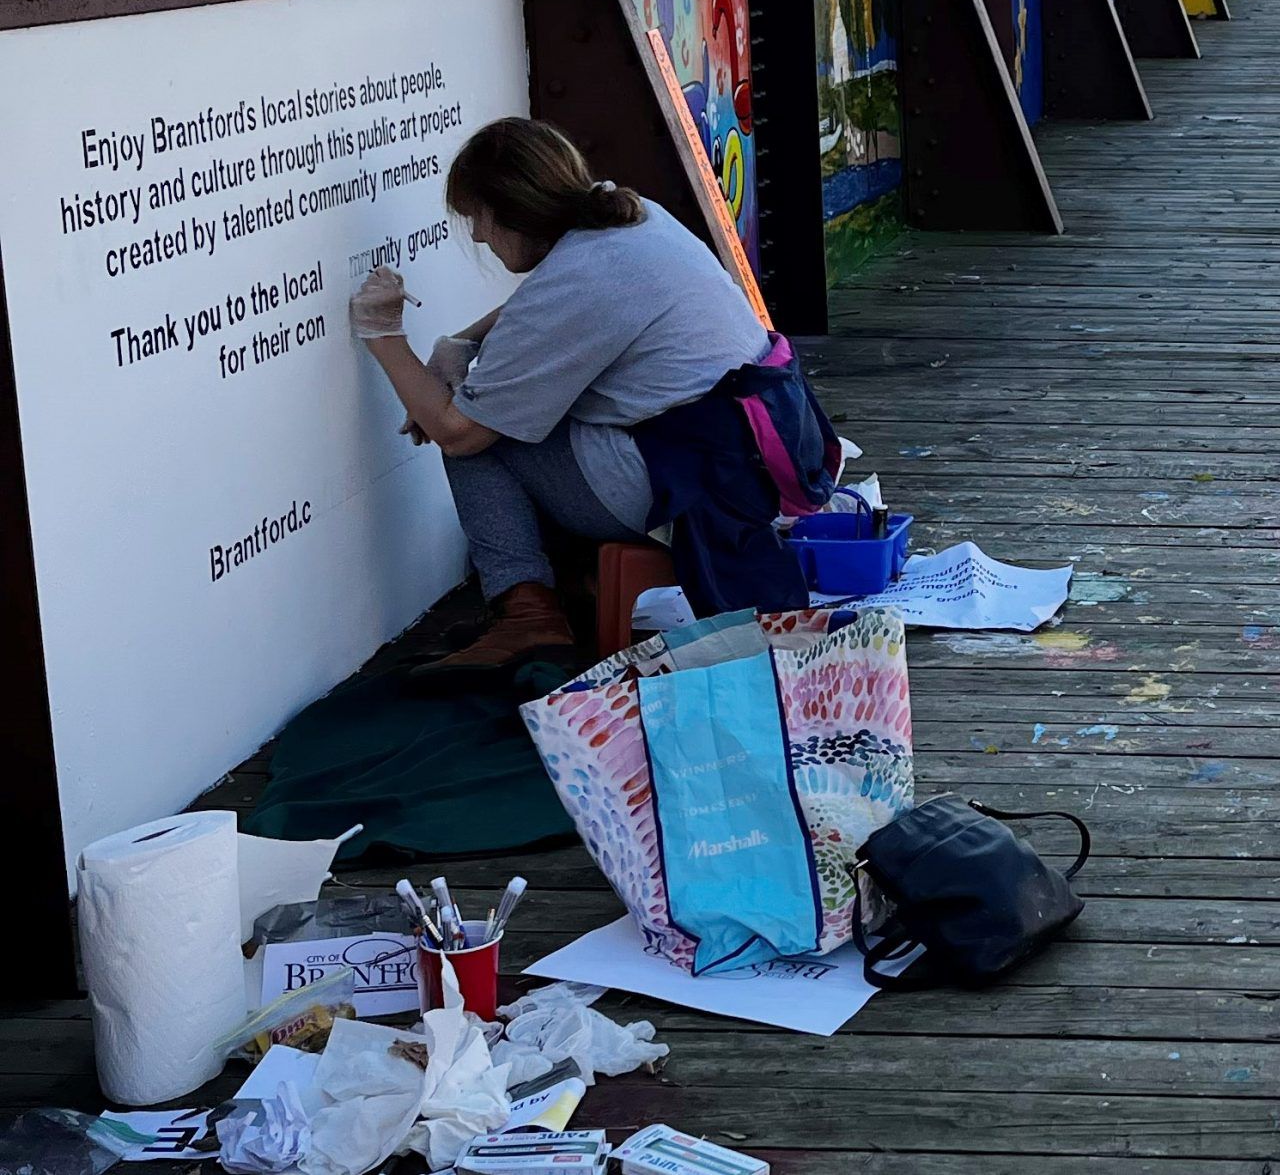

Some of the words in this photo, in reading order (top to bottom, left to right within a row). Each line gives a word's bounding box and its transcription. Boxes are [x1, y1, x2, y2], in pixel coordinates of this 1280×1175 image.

[81, 129, 145, 171] Enjoy
[151, 100, 257, 154] Brantford's
[261, 89, 302, 128] local
[304, 82, 356, 118] stories
[360, 72, 398, 105] about
[60, 187, 141, 234] history
[149, 167, 186, 209] and
[191, 159, 256, 197] culture
[260, 134, 325, 178] through
[327, 127, 354, 160] this
[357, 116, 397, 160] public
[400, 112, 418, 141] art
[420, 101, 462, 142] project
[106, 220, 188, 277] created
[192, 217, 216, 256] by
[223, 189, 294, 241] talented
[299, 168, 377, 217] community
[110, 313, 179, 367] Thank
[184, 305, 222, 351] you
[226, 293, 246, 325] to
[251, 282, 279, 315] the
[283, 260, 324, 303] local
[408, 219, 449, 262] groups
[219, 345, 247, 379] for
[252, 322, 290, 364] their
[296, 314, 325, 346] con
[210, 500, 312, 582] Brantford.c
[688, 829, 769, 860] Marshalls
[306, 954, 325, 964] CITY
[328, 953, 341, 963] OF
